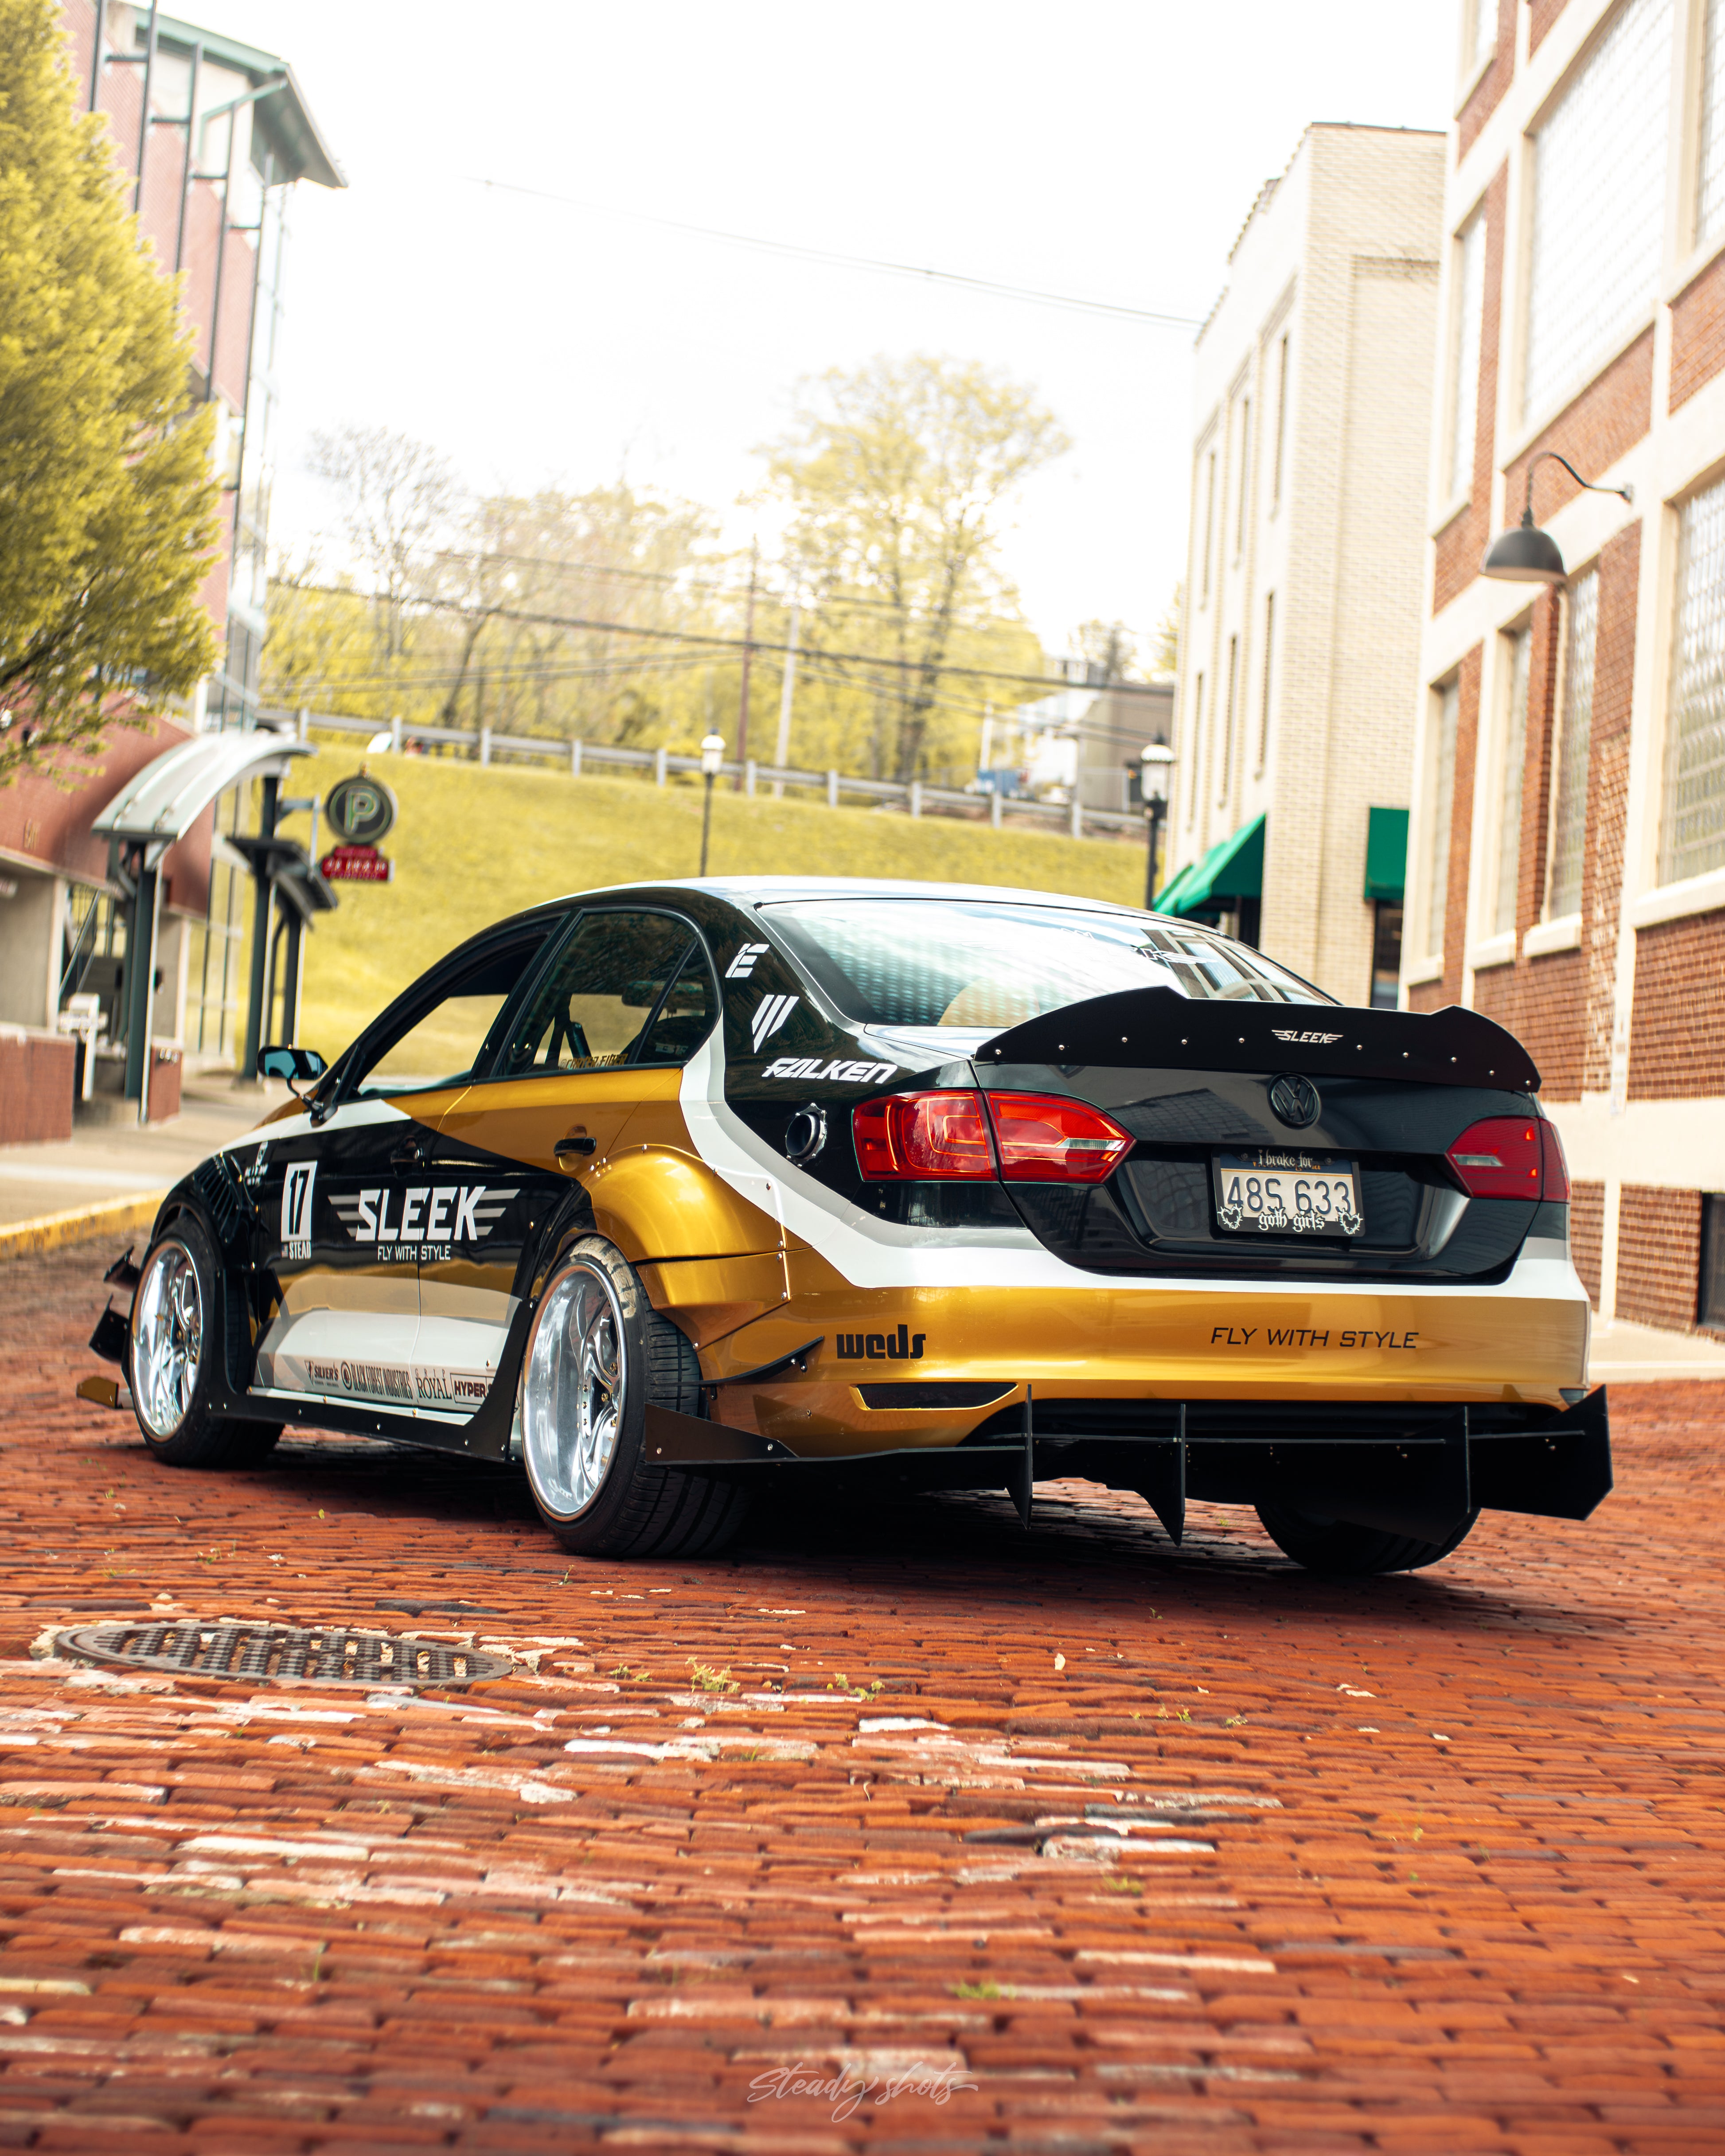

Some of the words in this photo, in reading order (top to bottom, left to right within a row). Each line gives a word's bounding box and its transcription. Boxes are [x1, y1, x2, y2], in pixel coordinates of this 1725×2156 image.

[344, 785, 380, 834] P
[1282, 1030, 1331, 1043] SLEEK
[761, 1057, 897, 1084] FALKEN
[1266, 1149, 1295, 1168] brake
[1297, 1151, 1312, 1168] for
[289, 1169, 310, 1235] 17
[1227, 1177, 1284, 1214] 485
[1295, 1180, 1350, 1215] 633
[355, 1186, 486, 1240] SLEEK
[1257, 1206, 1288, 1231] goth
[1292, 1209, 1325, 1232] girls
[378, 1245, 393, 1261] FLY
[395, 1245, 417, 1261] WITH
[421, 1245, 451, 1261] STYLE
[836, 1324, 926, 1359] weds
[1211, 1327, 1258, 1345] FLY
[1268, 1329, 1329, 1347] WITH
[1339, 1331, 1420, 1349] STYLE
[366, 1365, 385, 1396] FOREST
[382, 1367, 413, 1400] INDUSTRIES
[416, 1377, 453, 1400] ROYAL
[454, 1380, 486, 1398] HYPER
